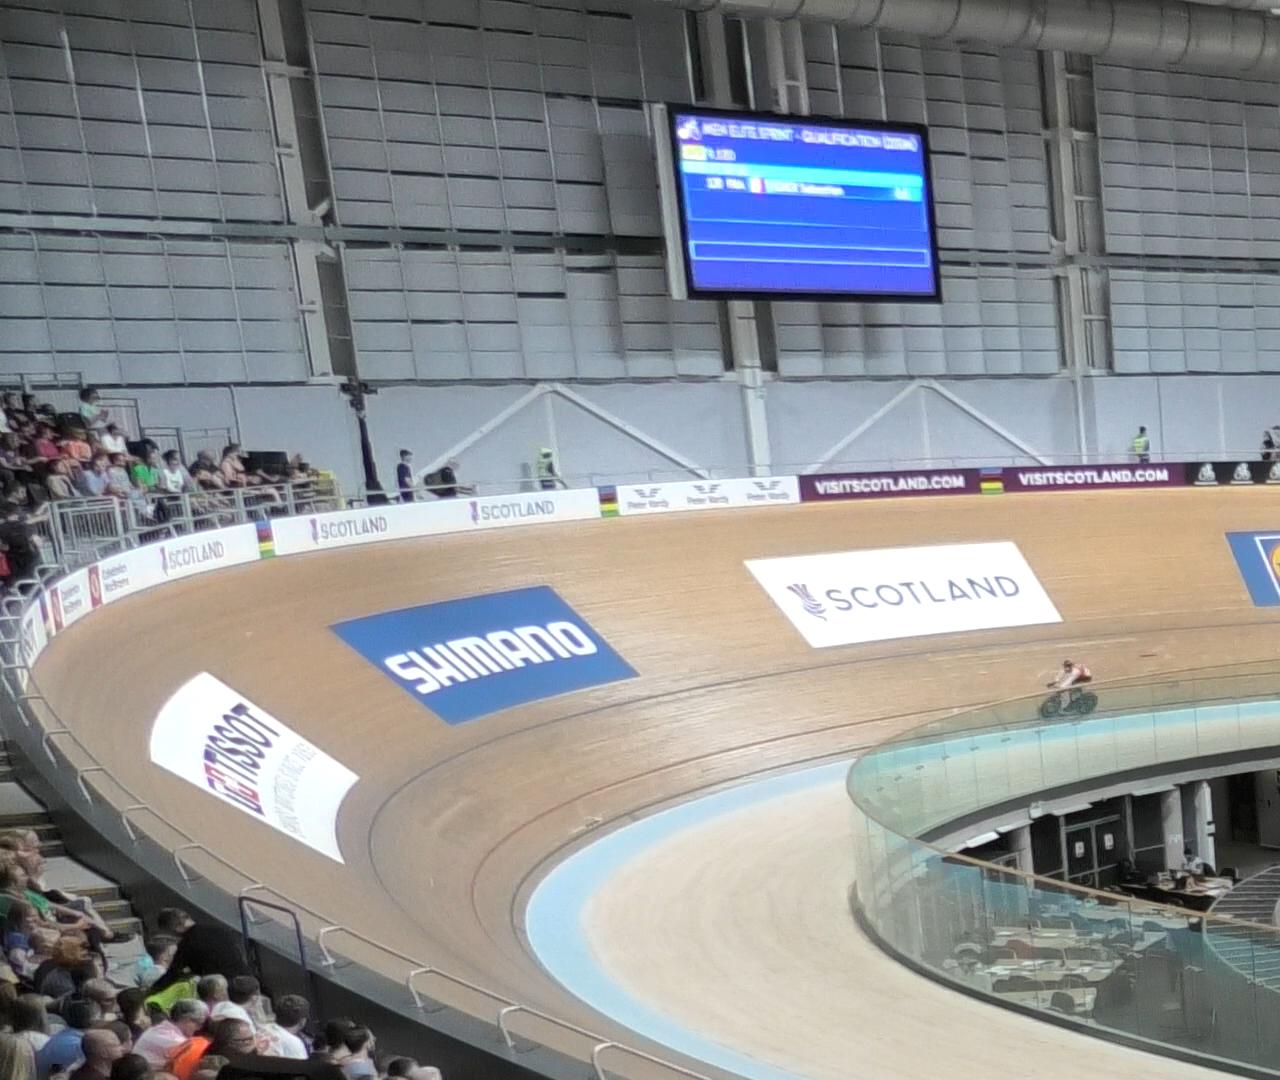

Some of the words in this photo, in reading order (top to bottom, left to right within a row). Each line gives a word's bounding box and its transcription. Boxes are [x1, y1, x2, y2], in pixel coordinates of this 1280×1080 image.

[815, 474, 966, 497] VISITSCOTLAND.COM
[1019, 466, 1169, 487] VISITSCOTLAND.COM
[481, 500, 555, 521] SCOTLAND
[320, 516, 388, 541] SCOTLAND
[168, 541, 224, 570] SCOTLAND
[827, 574, 1020, 613] SCOTLAND
[384, 621, 598, 695] SHIMANO
[204, 702, 280, 786] TISSOT
